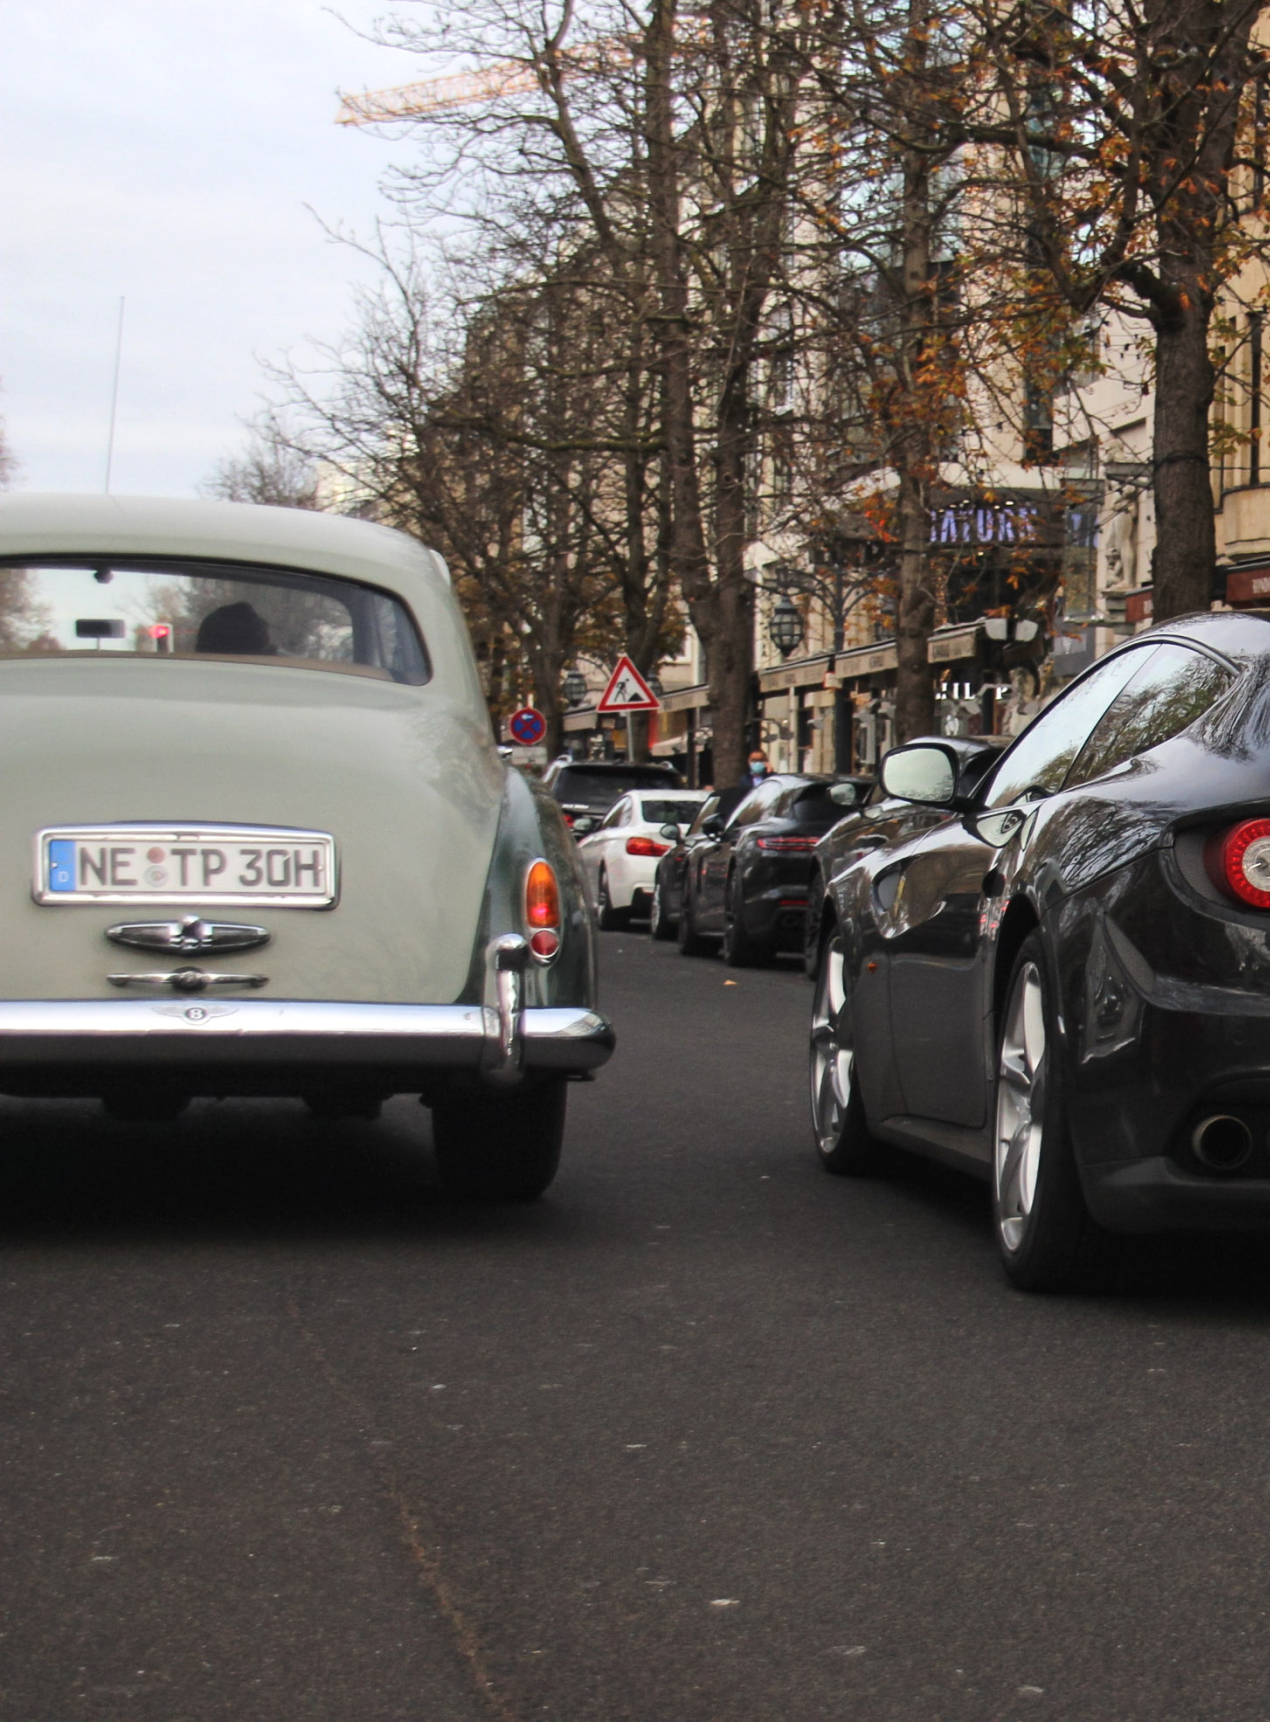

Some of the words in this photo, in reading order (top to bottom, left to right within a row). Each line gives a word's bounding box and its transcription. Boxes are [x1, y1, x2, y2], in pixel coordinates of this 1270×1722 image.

[80, 847, 138, 886] NE
[171, 848, 228, 887] TP
[239, 848, 321, 888] 30H
